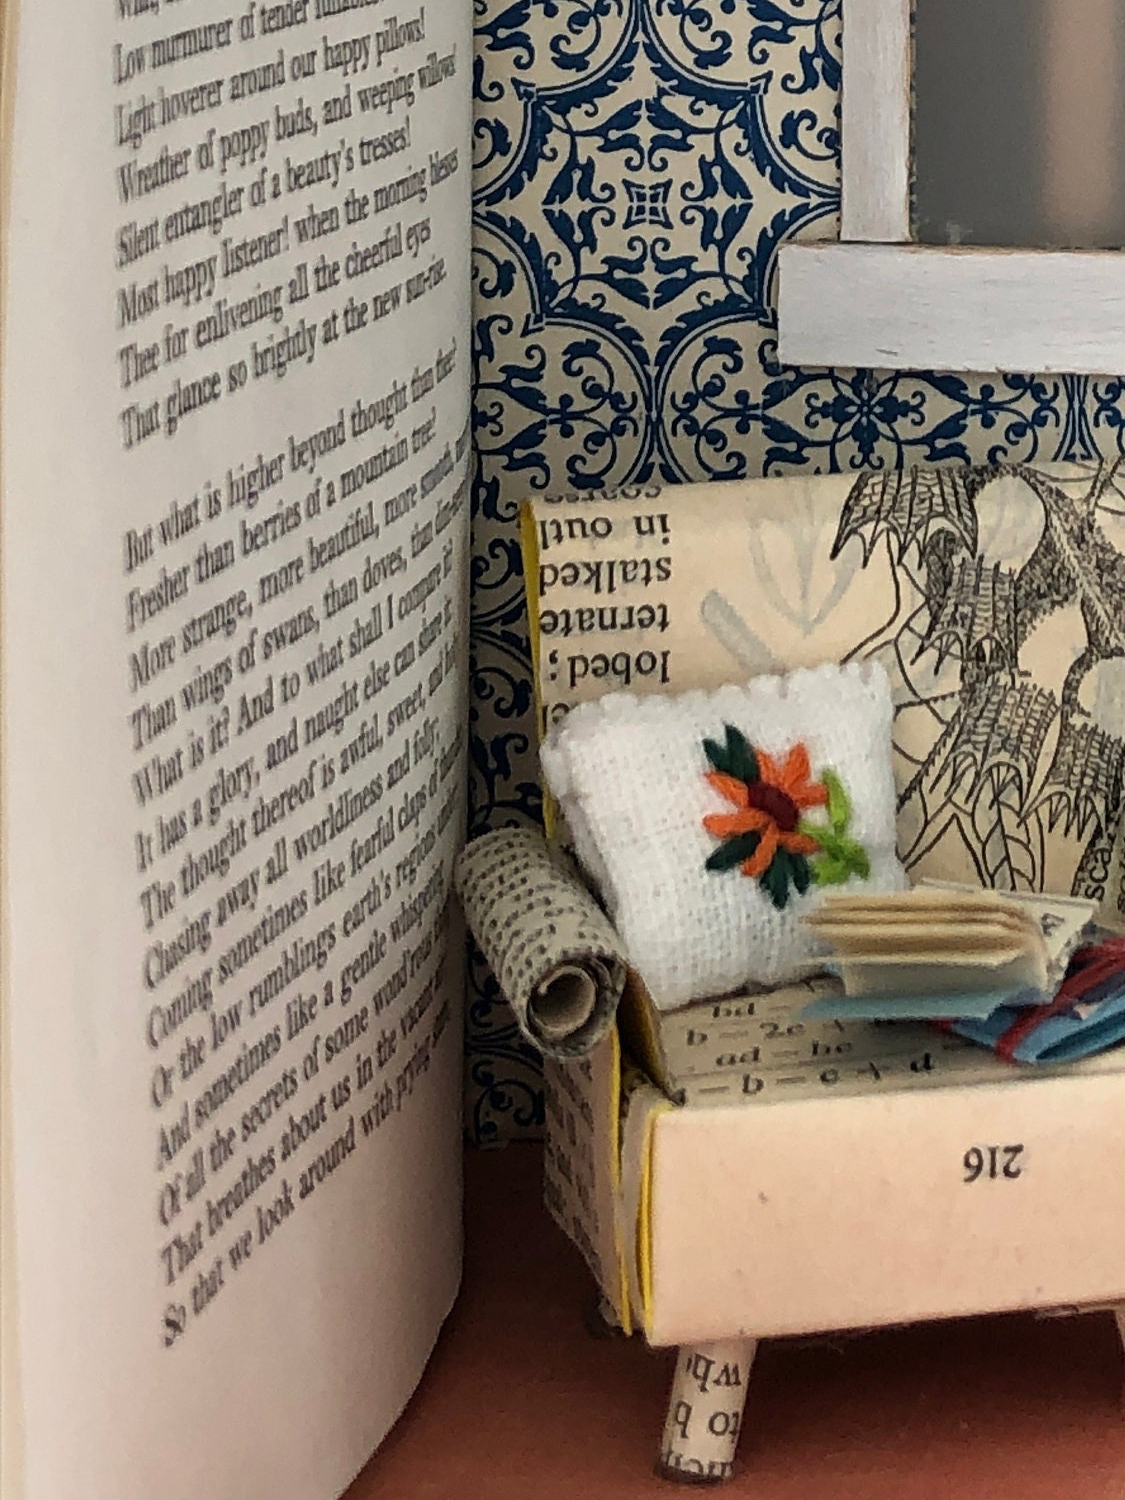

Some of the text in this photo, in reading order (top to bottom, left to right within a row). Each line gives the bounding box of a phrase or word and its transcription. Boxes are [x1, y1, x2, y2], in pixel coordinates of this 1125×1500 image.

[152, 16, 232, 69] murmurer
[230, 48, 285, 100] around
[290, 47, 317, 80] our
[323, 35, 371, 76] happy
[220, 117, 270, 174] poppy
[323, 85, 352, 124] and
[286, 139, 354, 192] beauty's
[222, 188, 369, 277] listener! when the
[289, 223, 402, 304] all cheerful
[228, 283, 402, 392] so at the new
[226, 380, 408, 508] higher beyond thought
[195, 537, 234, 583] than
[240, 500, 300, 555] berries
[634, 513, 671, 545] in
[323, 578, 358, 619] than
[538, 556, 672, 595] stalked
[540, 602, 670, 637] ternate
[181, 759, 318, 896] thought thereof
[218, 888, 307, 983] sometimes
[312, 861, 345, 905] like
[249, 923, 336, 1016] rumblings
[286, 992, 317, 1040] like
[325, 1004, 369, 1062] some
[280, 1074, 350, 1160] about us
[257, 1078, 394, 1244] look around with
[963, 1143, 1025, 1182] 216
